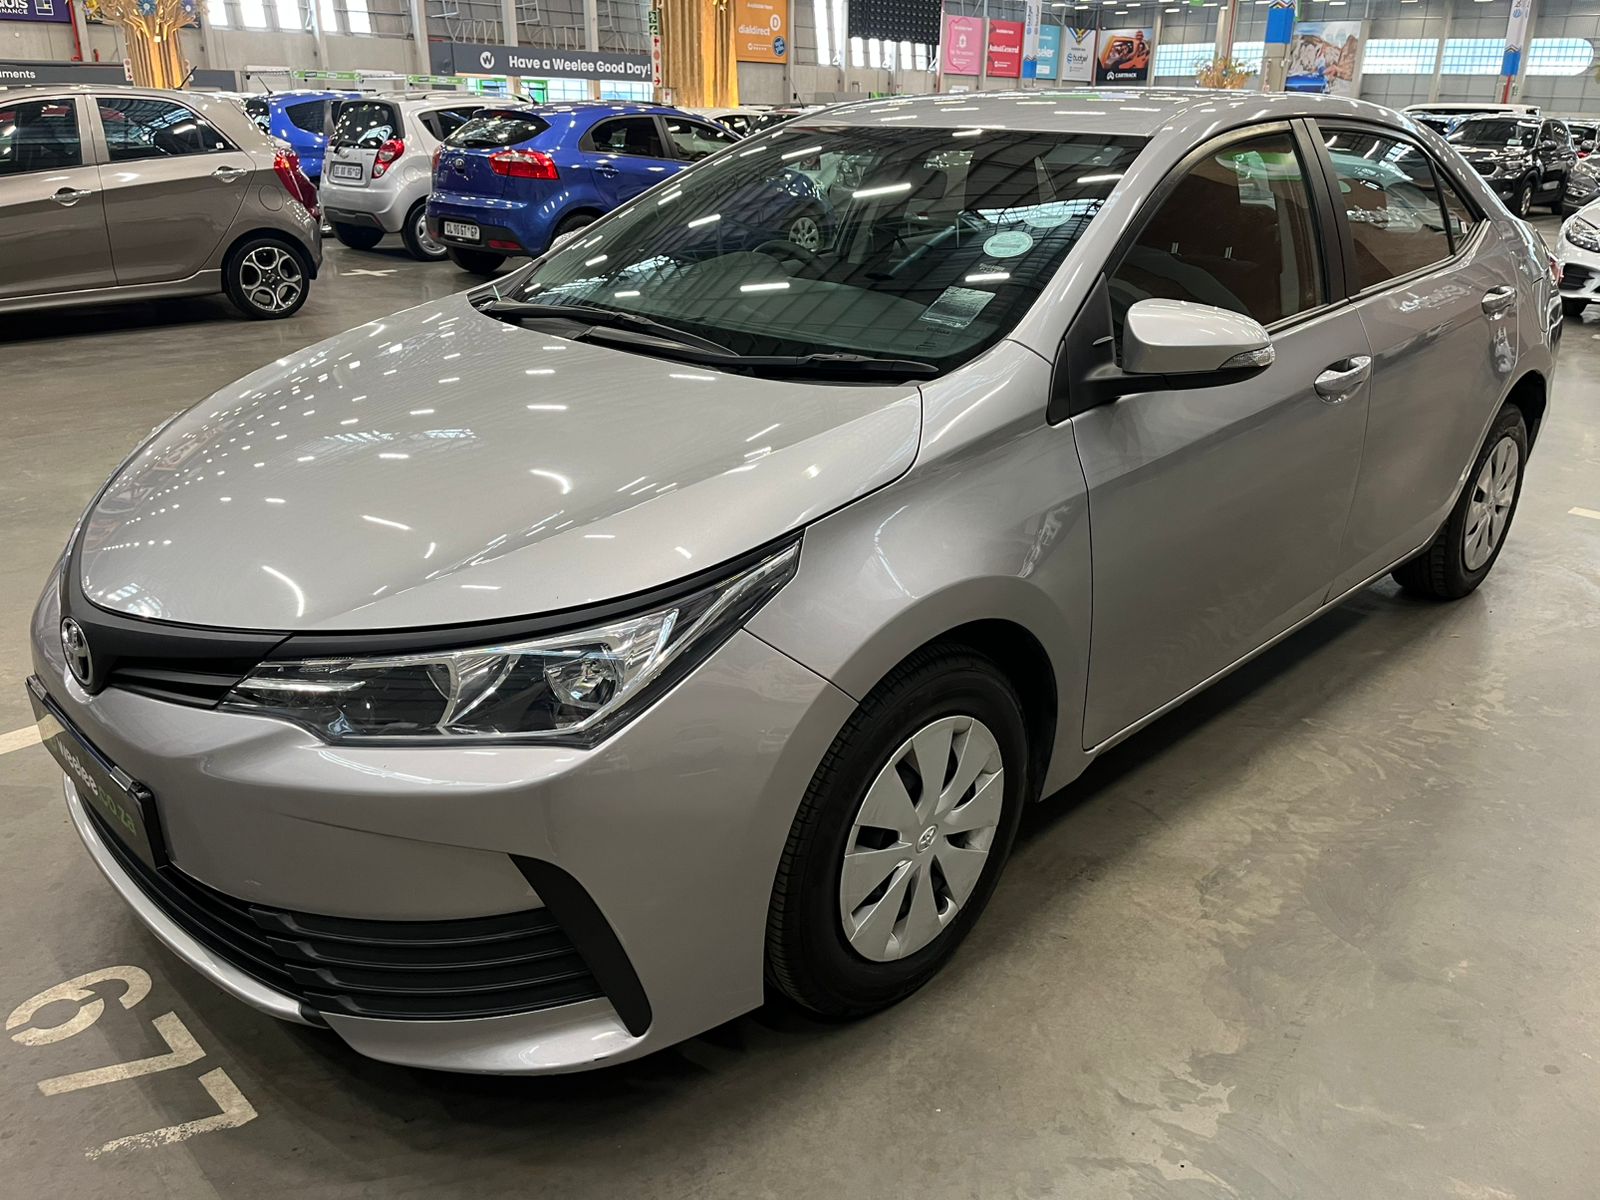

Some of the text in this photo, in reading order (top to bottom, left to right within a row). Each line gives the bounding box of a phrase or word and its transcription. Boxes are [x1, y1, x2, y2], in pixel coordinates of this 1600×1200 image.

[738, 24, 770, 36] dialdirect
[509, 56, 651, 78] Have a Weelee Good Day!
